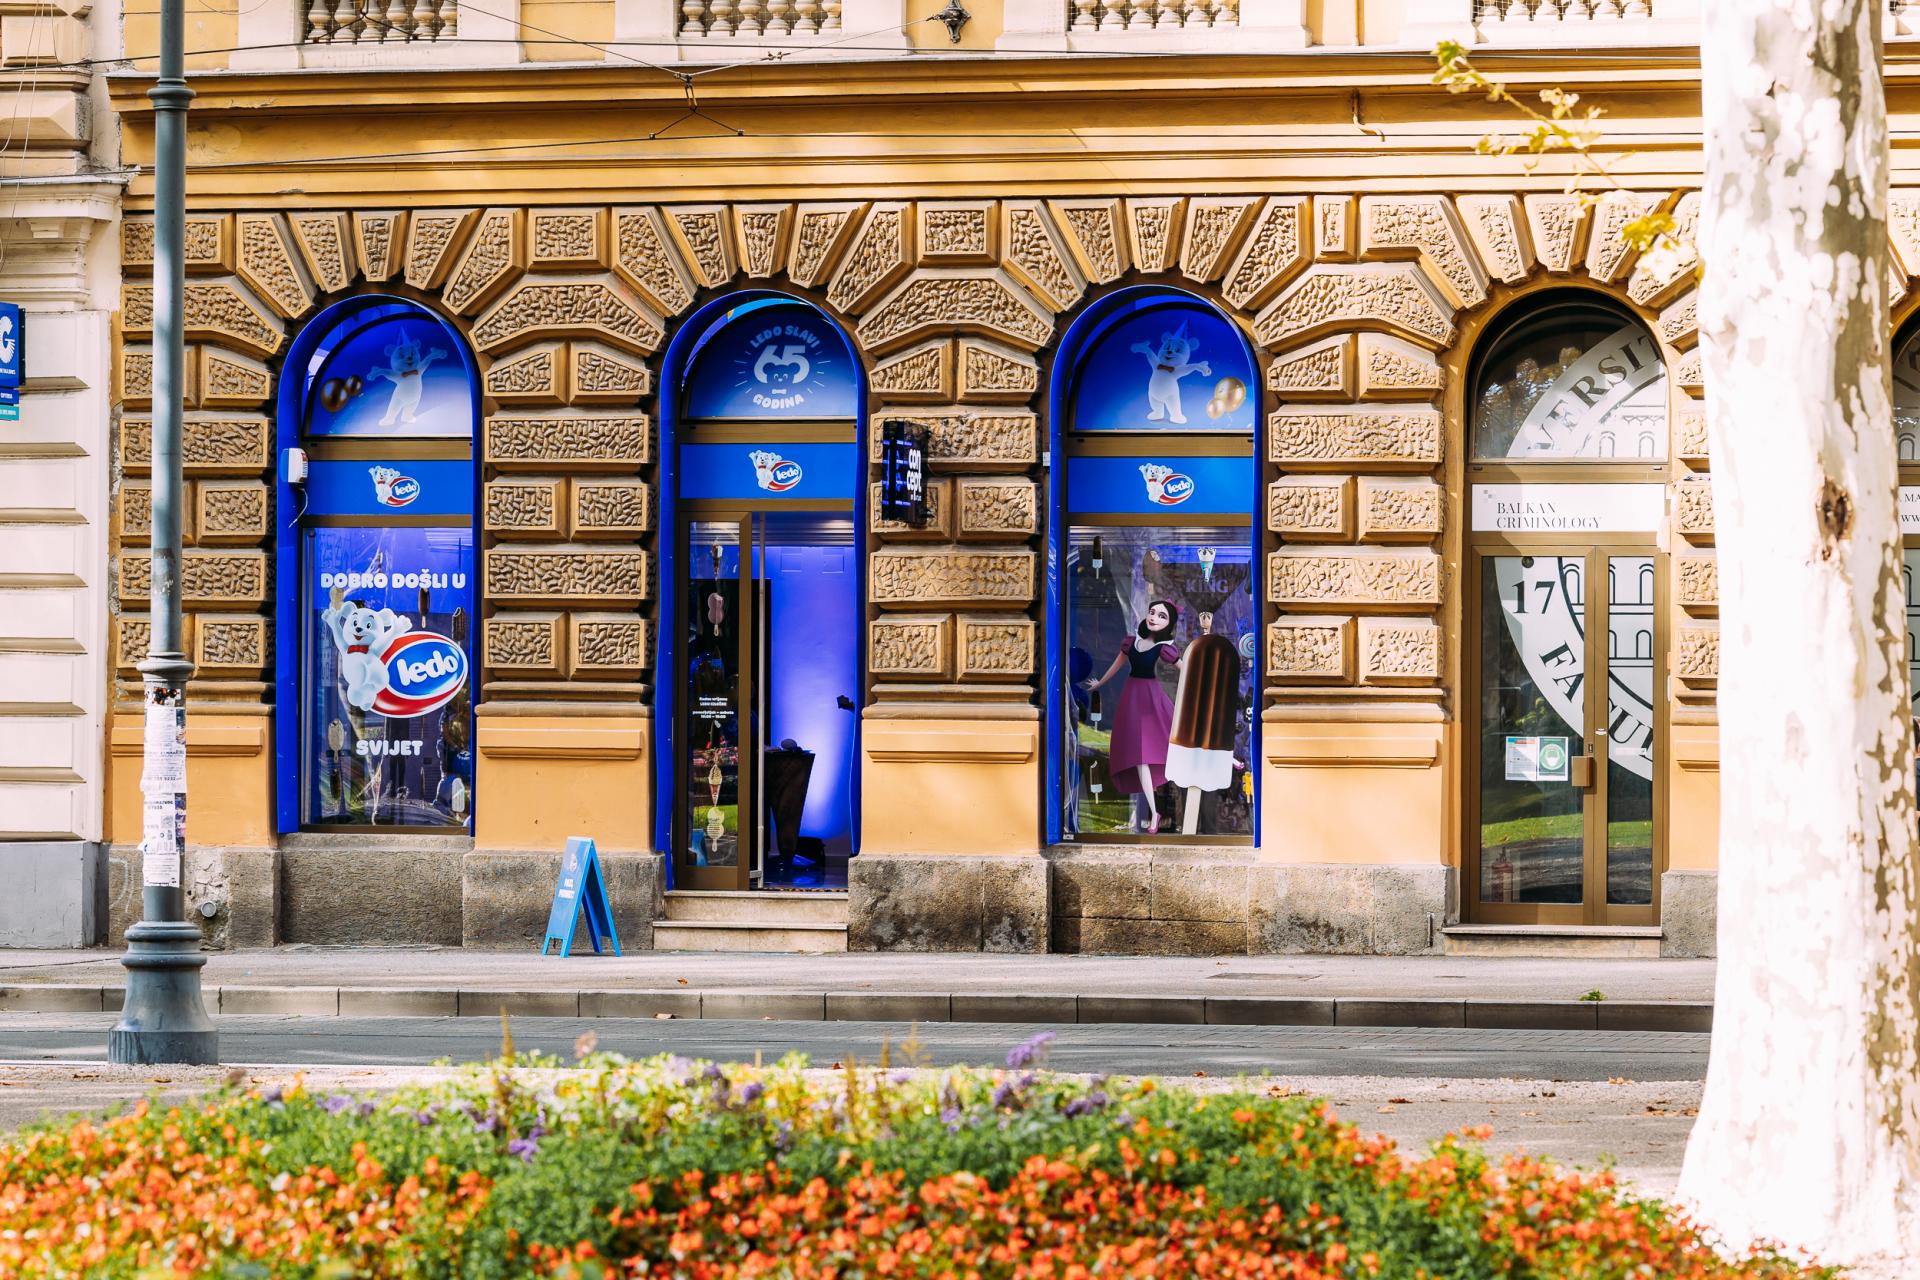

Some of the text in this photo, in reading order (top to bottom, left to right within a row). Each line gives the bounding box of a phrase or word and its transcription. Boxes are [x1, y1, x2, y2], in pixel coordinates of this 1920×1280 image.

[750, 325, 820, 348] LEDO SLAVI
[754, 345, 810, 384] 65
[753, 393, 805, 409] GODINA
[776, 467, 799, 481] ledo
[394, 483, 417, 496] ledo
[1167, 480, 1191, 494] ledo
[1497, 502, 1556, 514] BALKAN
[1496, 516, 1601, 528] CRIMINOLOGY
[320, 568, 466, 589] DOBRO DOŠLI U
[1511, 581, 1556, 615] 17
[396, 650, 459, 687] ledo
[355, 739, 424, 757] SVIJET
